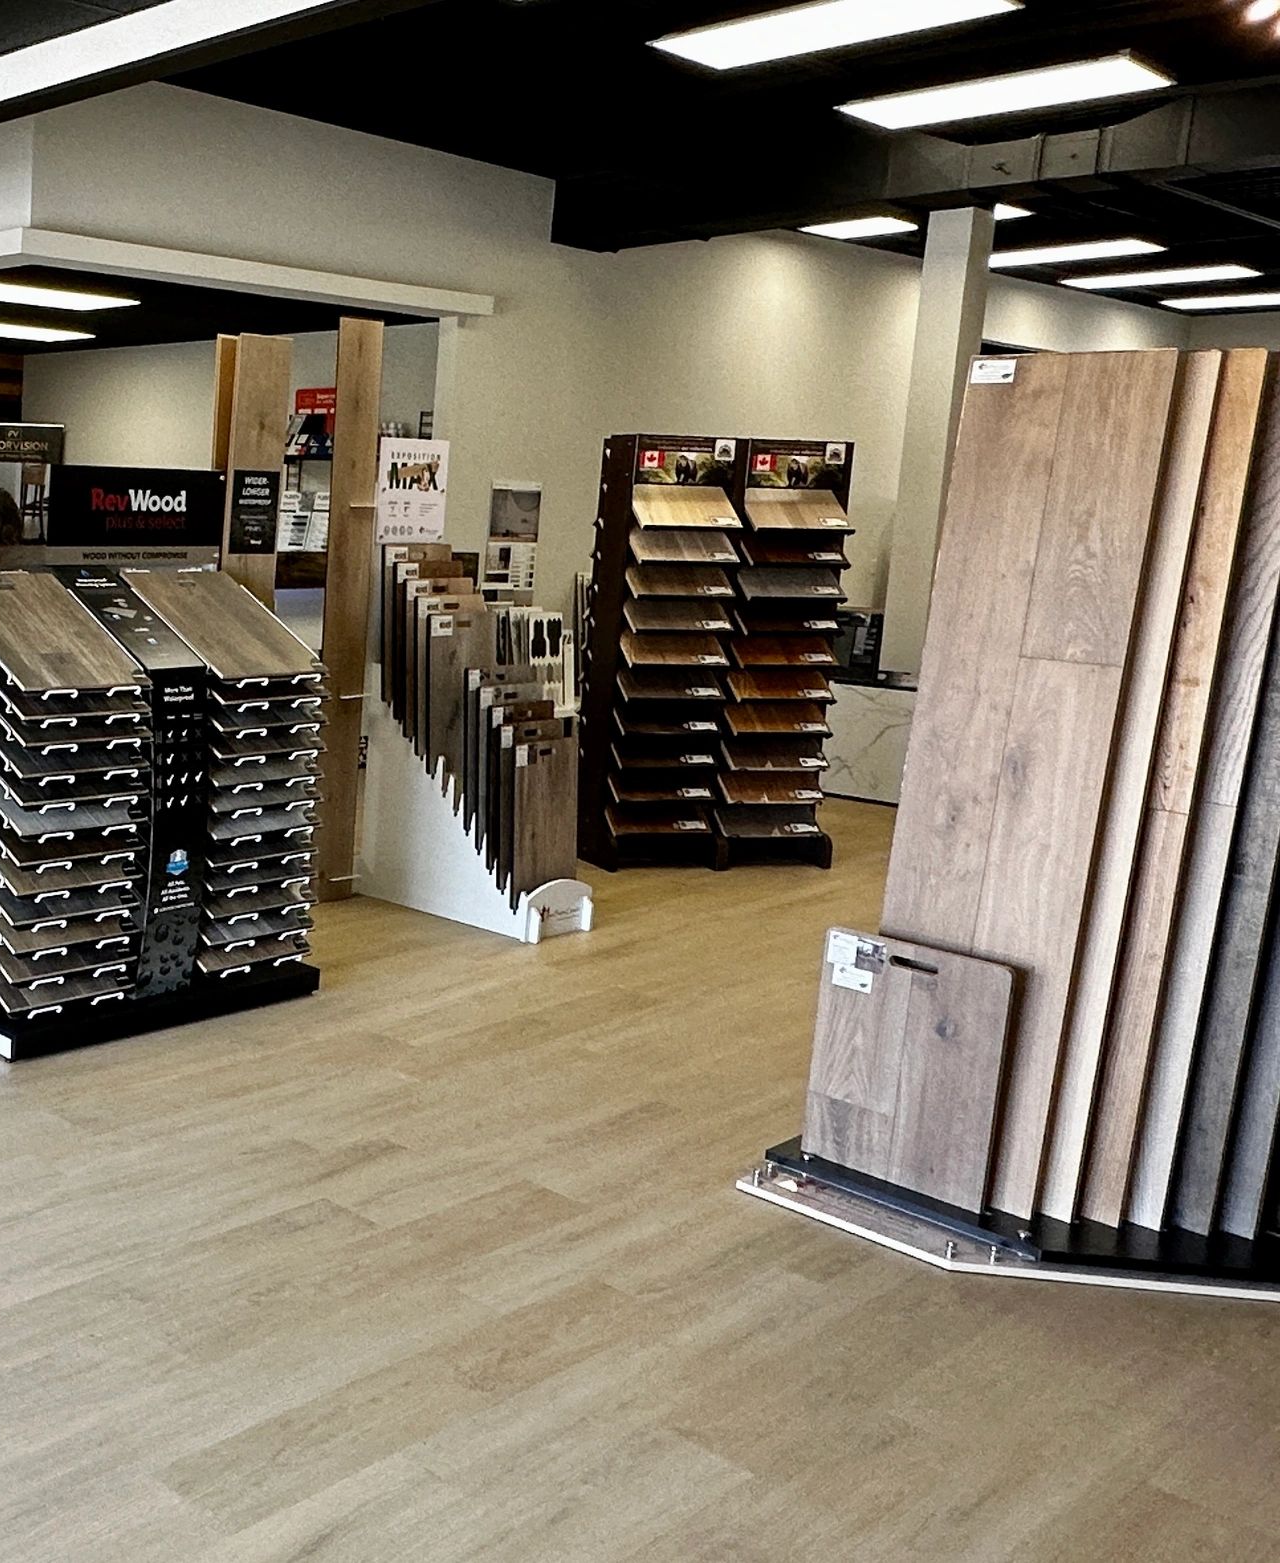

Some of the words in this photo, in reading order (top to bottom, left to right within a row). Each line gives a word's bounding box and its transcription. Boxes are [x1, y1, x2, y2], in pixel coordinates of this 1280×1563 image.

[391, 451, 441, 461] EXPOSITION
[91, 487, 187, 512] RevWood
[82, 552, 107, 560] WOOD
[108, 552, 140, 560] WITHOUT
[141, 551, 188, 559] COMPROMISE
